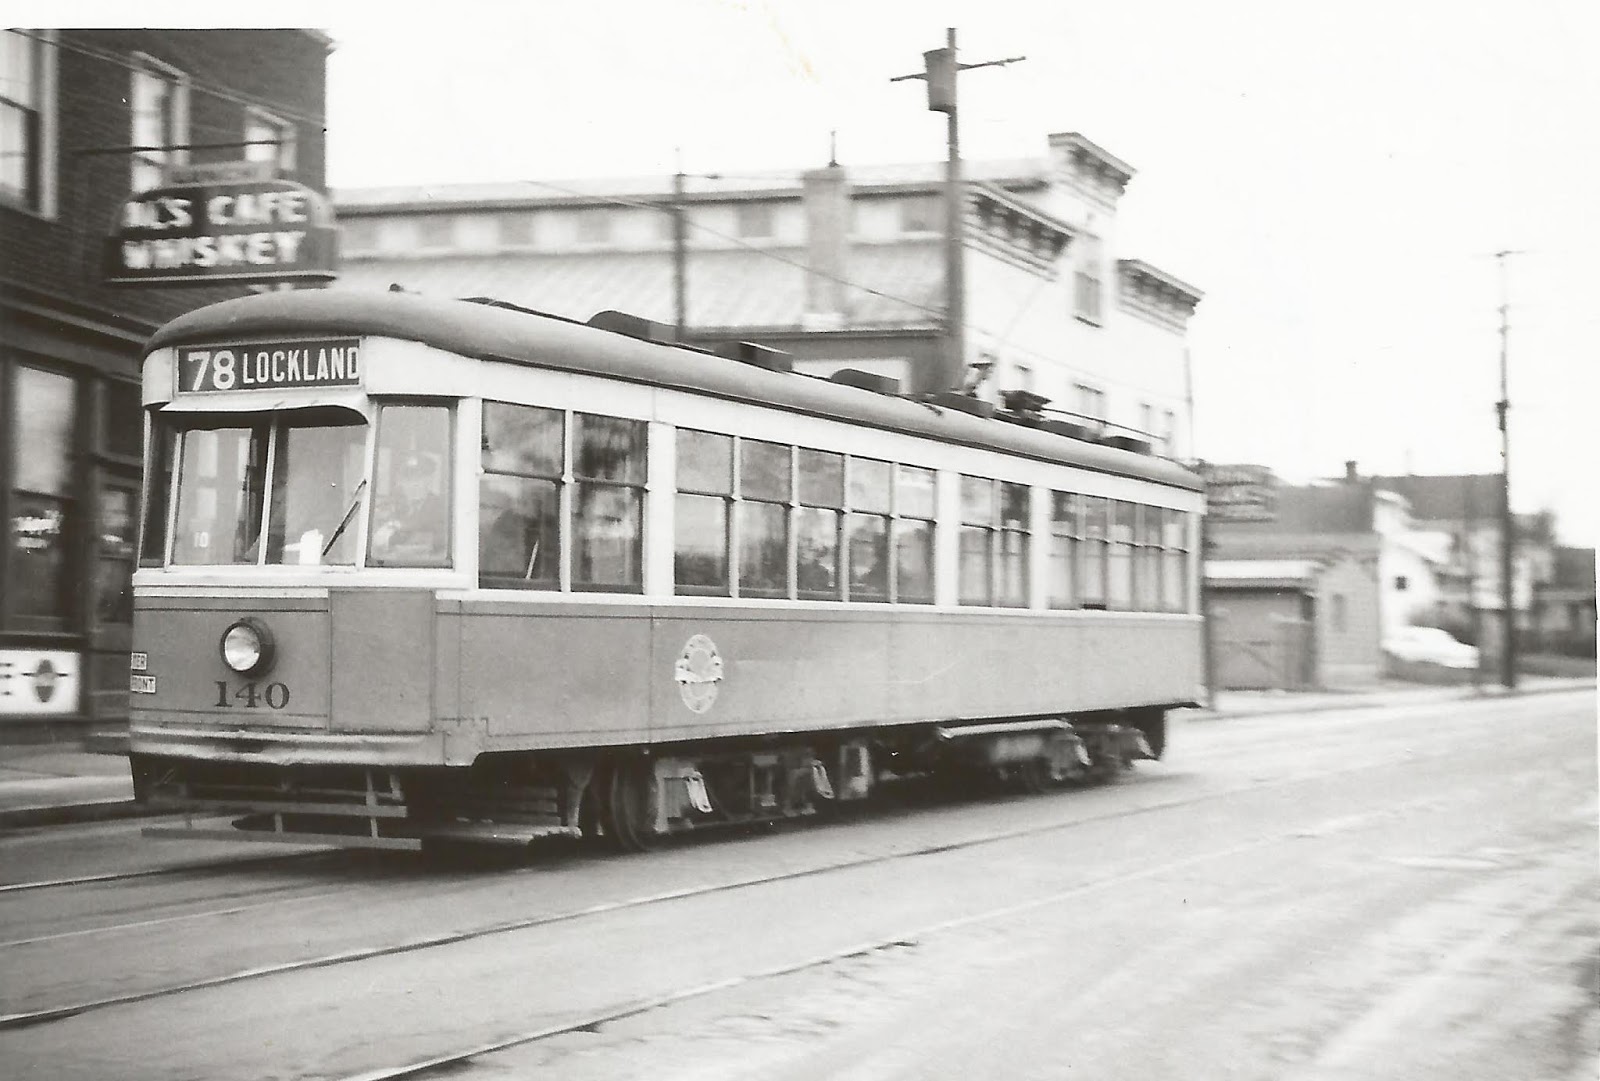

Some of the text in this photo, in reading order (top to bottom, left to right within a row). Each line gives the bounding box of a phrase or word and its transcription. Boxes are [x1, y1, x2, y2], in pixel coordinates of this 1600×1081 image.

[207, 191, 308, 225] CAFE
[122, 231, 307, 269] WHISKEY
[187, 347, 360, 391] 78 LOCKLAND
[214, 681, 290, 710] 140
